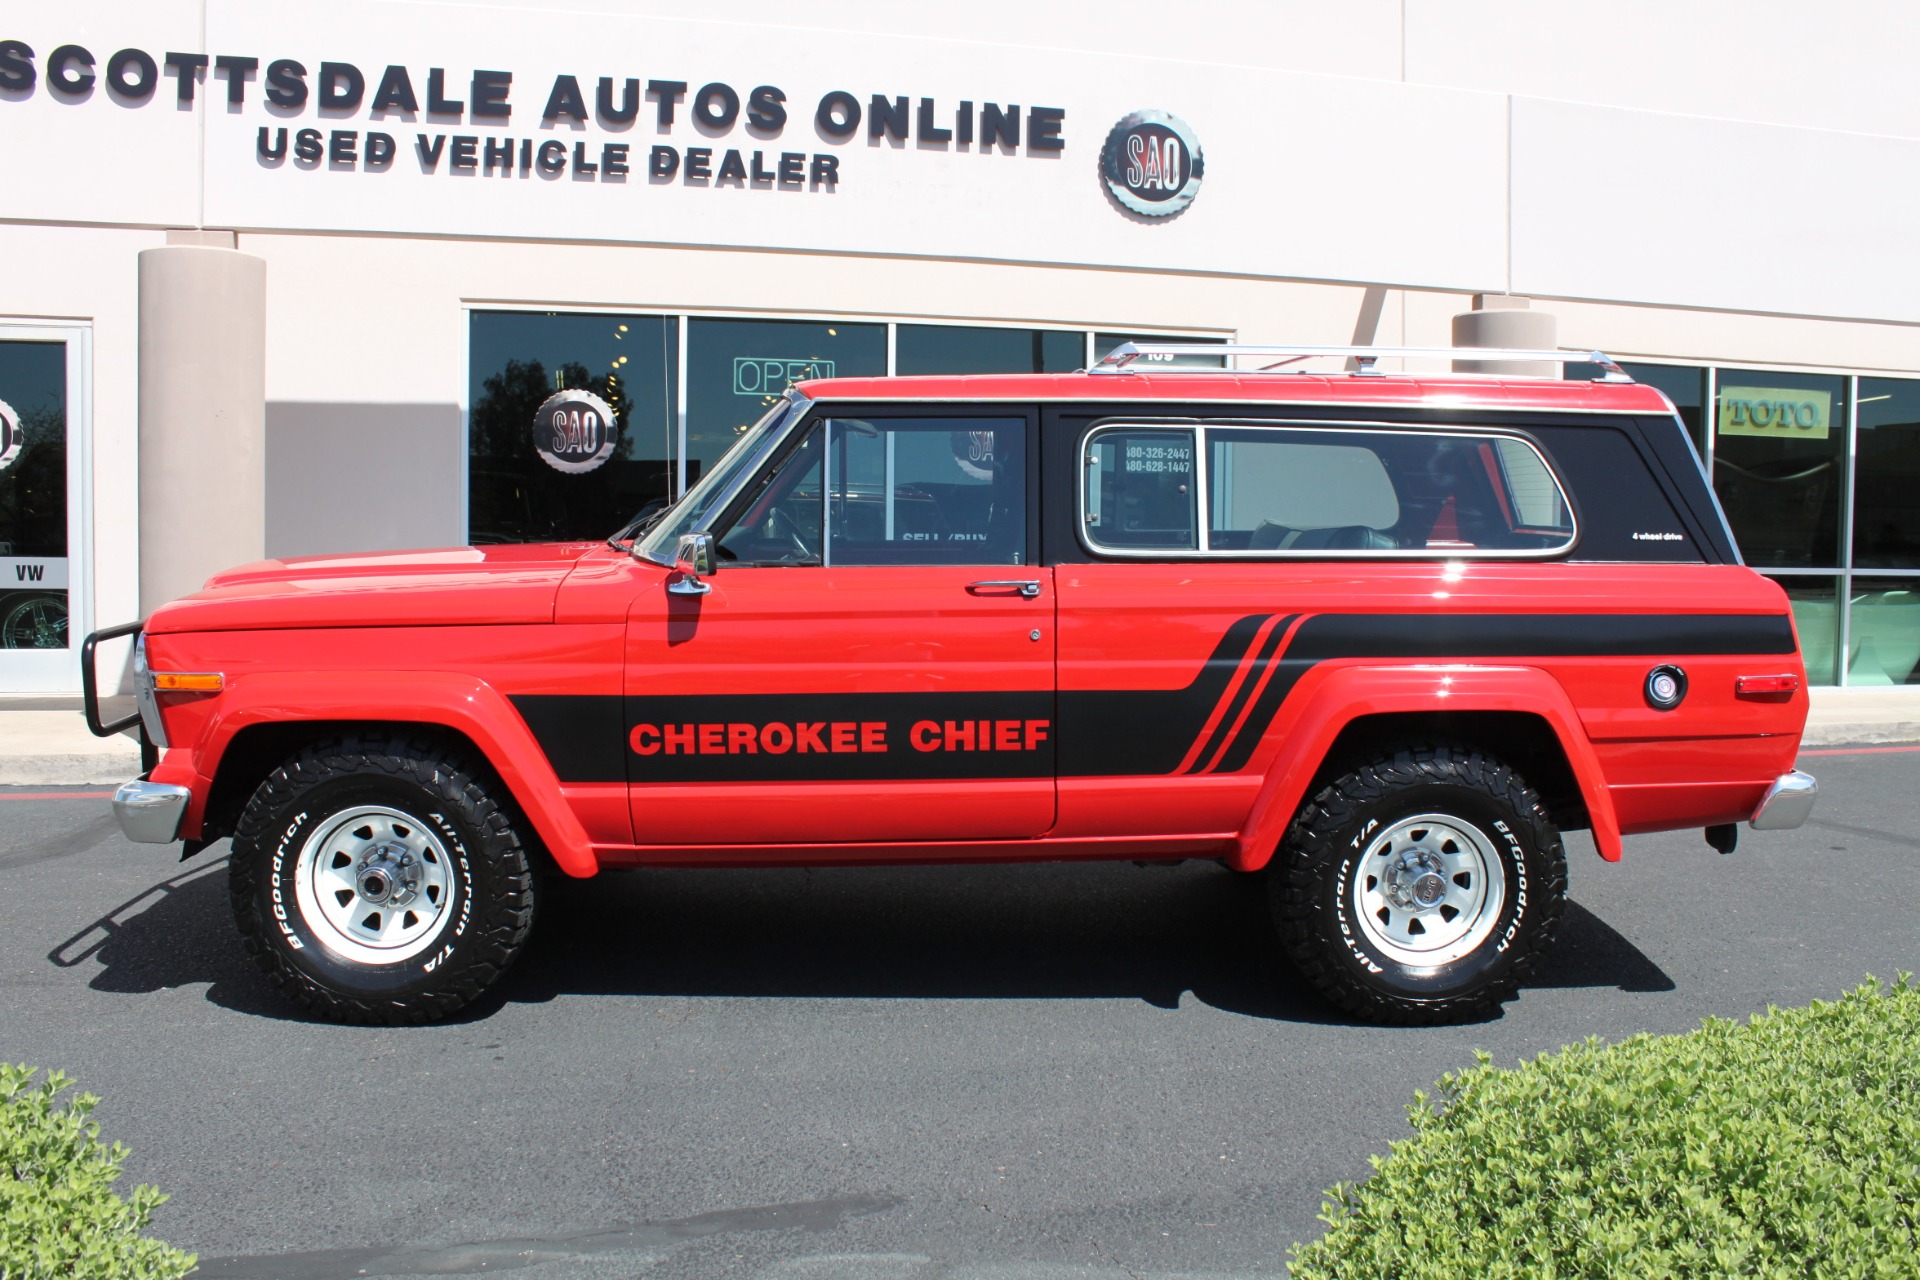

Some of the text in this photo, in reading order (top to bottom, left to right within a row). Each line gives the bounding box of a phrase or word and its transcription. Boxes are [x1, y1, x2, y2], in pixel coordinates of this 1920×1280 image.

[0, 40, 1065, 151] SCOTTSDALE AUTOS ONLINE
[259, 127, 839, 184] USED VEHICLE DEALER
[1127, 134, 1180, 191] SAO
[739, 361, 830, 391] OPEN
[552, 410, 598, 454] SAO
[1727, 398, 1819, 430] TOTO
[1632, 532, 1683, 541] 4 wheel drive
[16, 564, 45, 582] VW
[629, 719, 1050, 756] CHEROKEE CHIEF
[270, 811, 308, 951] BFGoodrich
[422, 811, 475, 974] All-Terrain T/A
[1334, 817, 1384, 974] All-Terrain T/A
[1492, 820, 1528, 953] BFGoodrich
